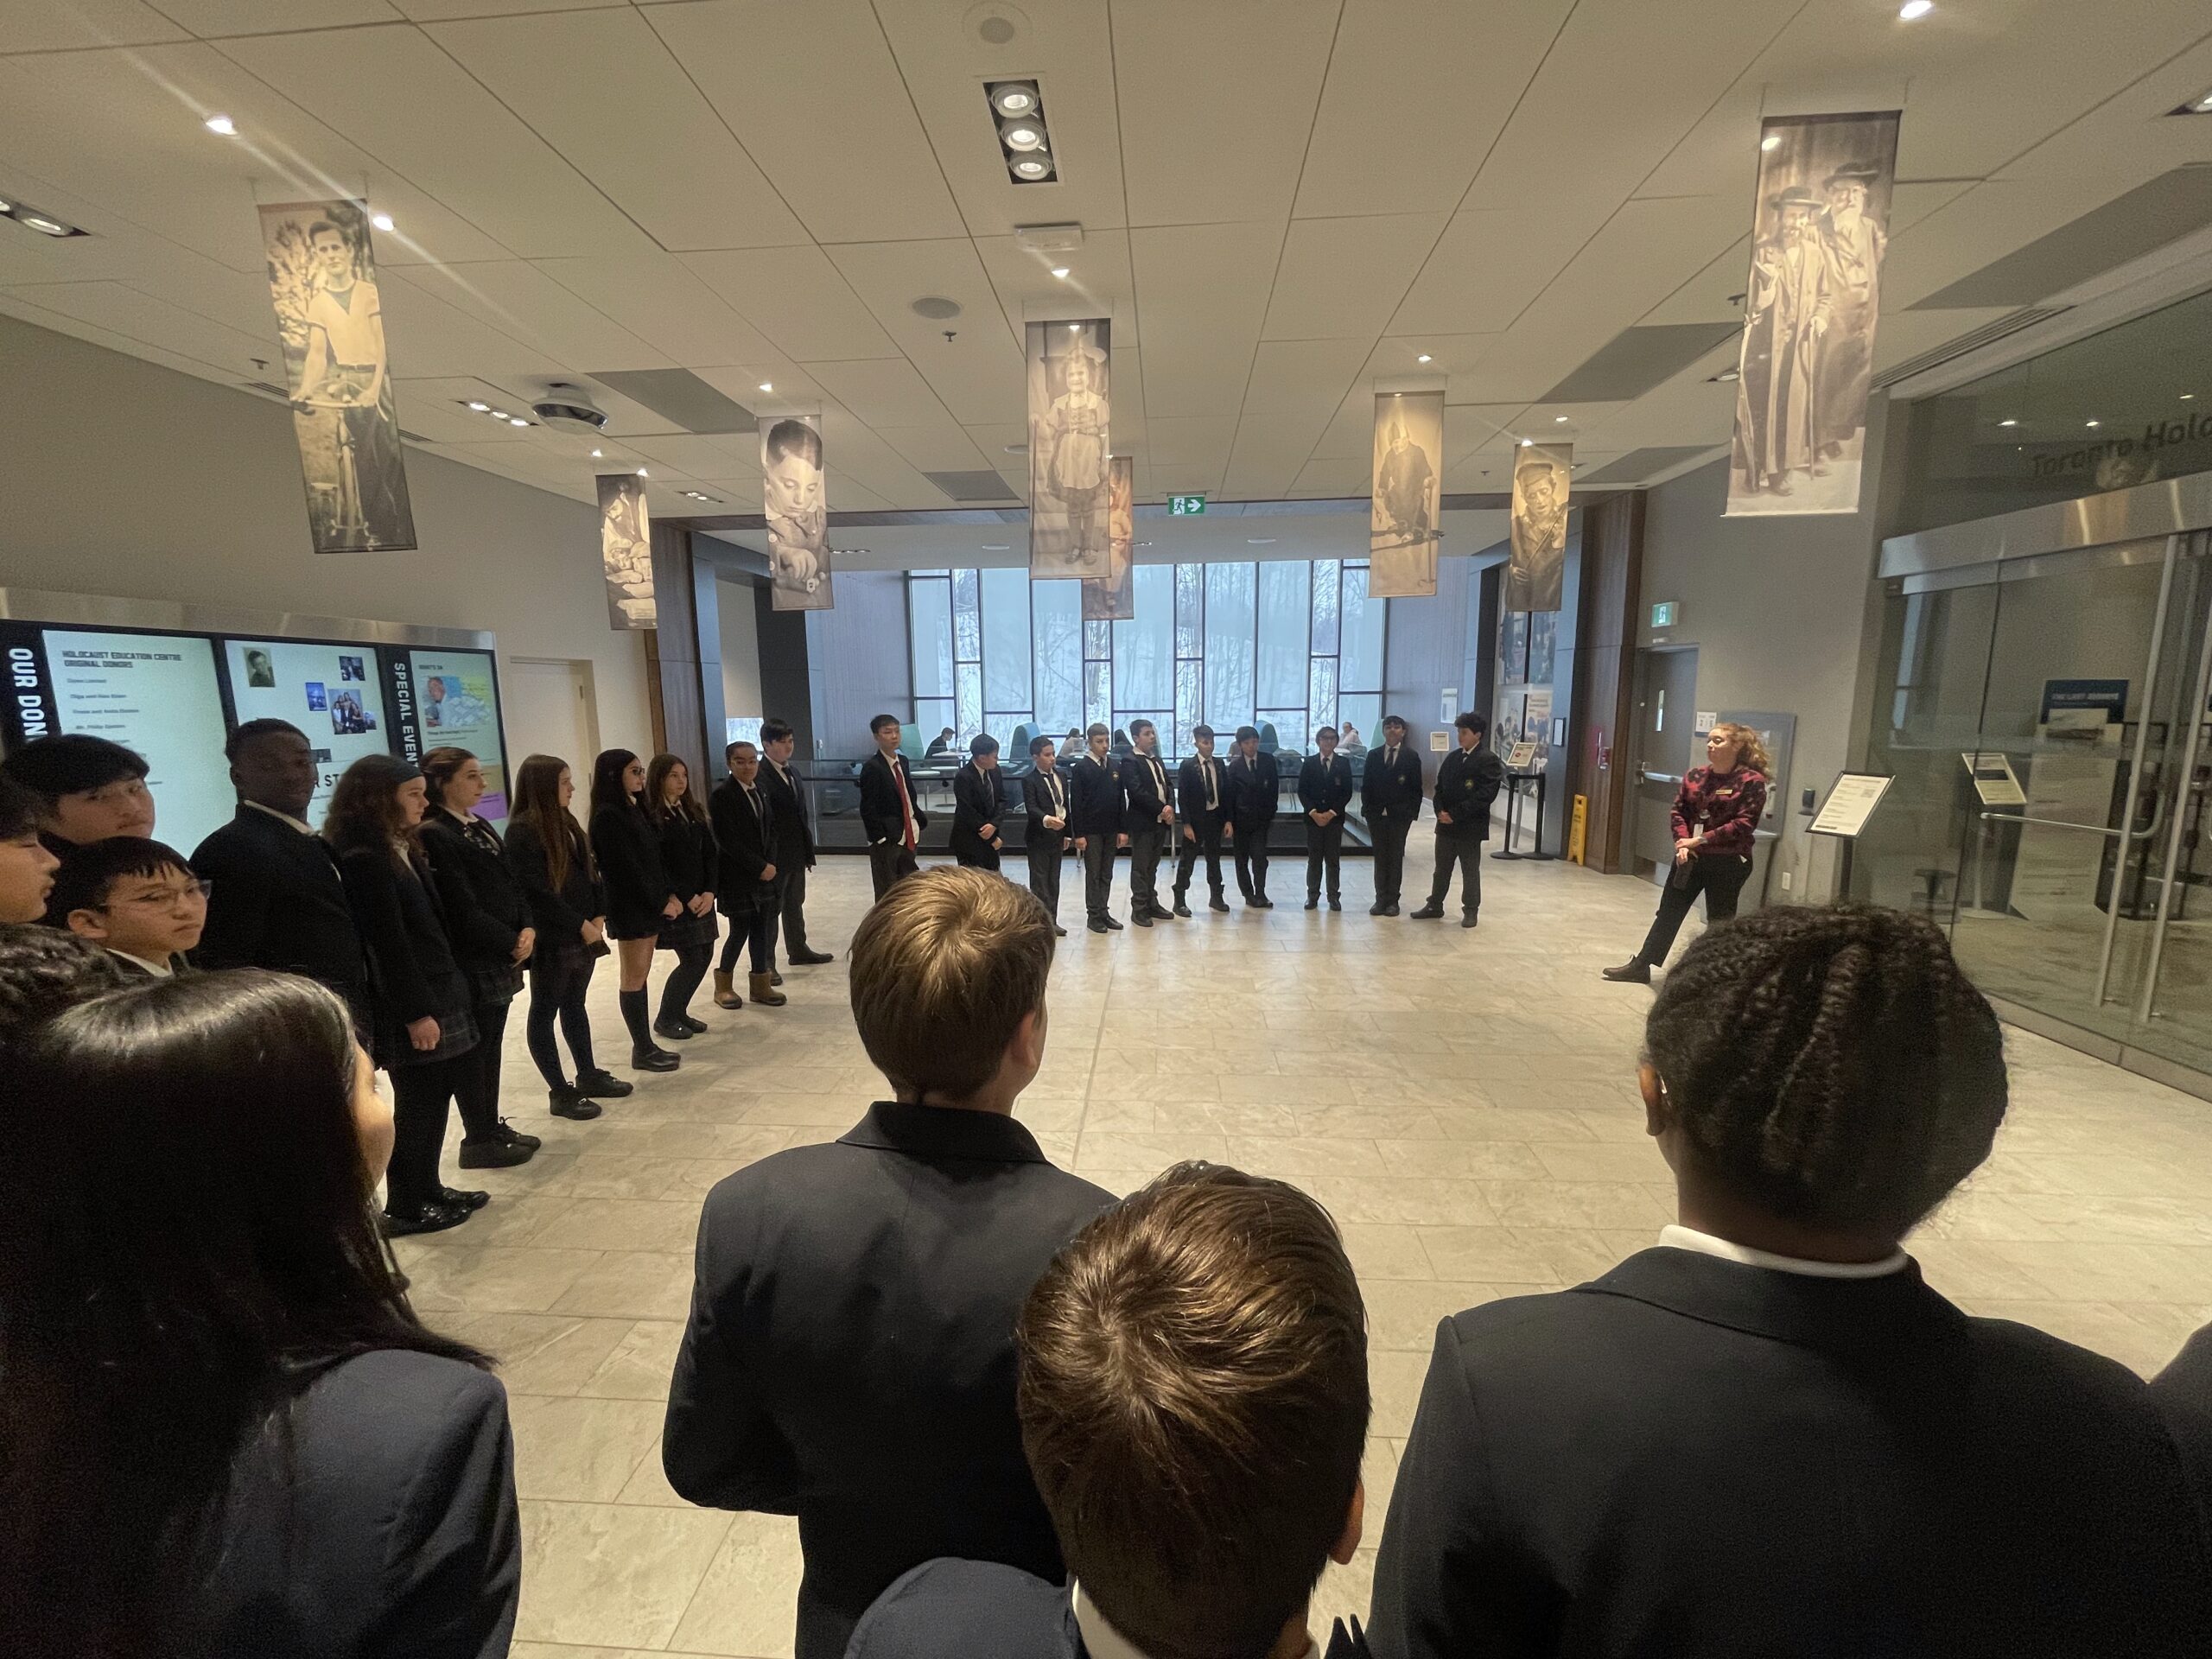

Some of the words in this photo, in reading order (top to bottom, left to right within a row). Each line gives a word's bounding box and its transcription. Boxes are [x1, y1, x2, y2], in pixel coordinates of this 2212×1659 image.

[9, 648, 38, 688] OUR
[62, 650, 109, 658] HOLOCAUST
[111, 652, 153, 660] EDUCATION
[394, 663, 412, 721] SPECIAL
[17, 695, 48, 742] DON
[402, 725, 419, 768] EVENT
